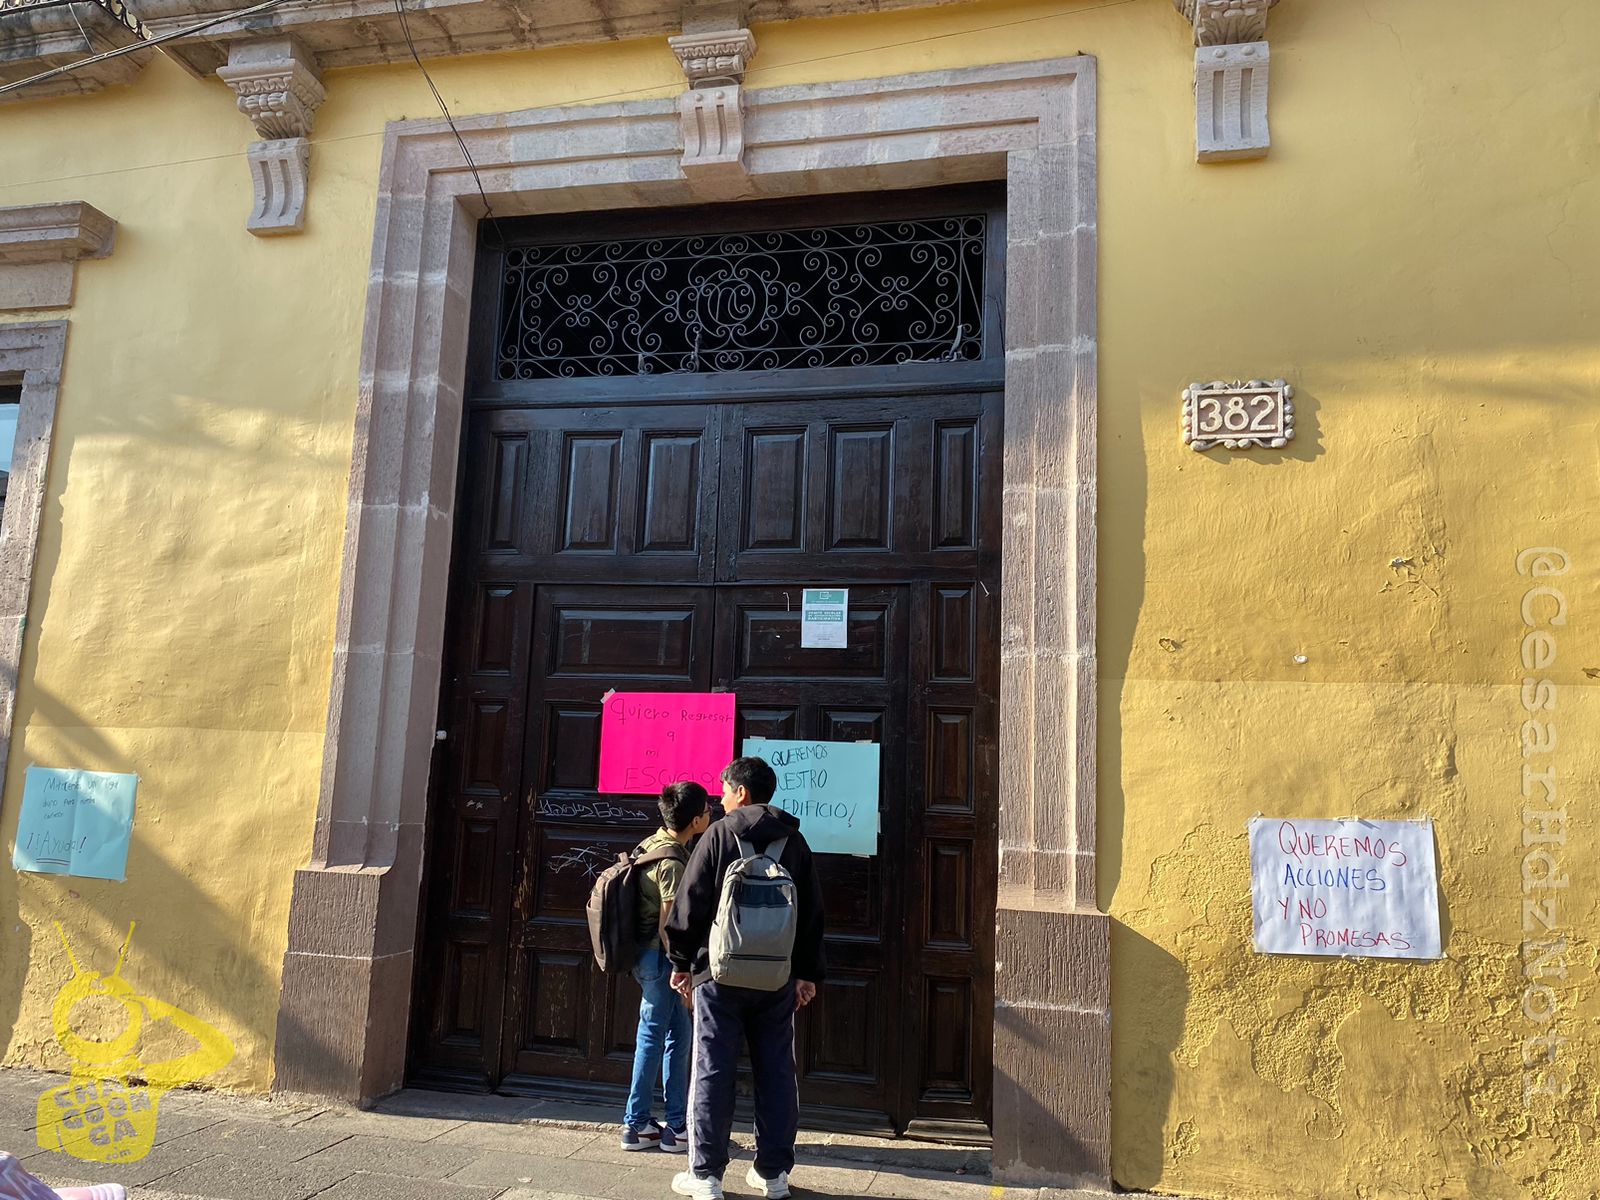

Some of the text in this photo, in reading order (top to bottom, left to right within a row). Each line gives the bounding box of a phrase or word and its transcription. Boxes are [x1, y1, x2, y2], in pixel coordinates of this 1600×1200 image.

[1199, 394, 1276, 432] 382
[771, 744, 828, 767] QUEREMOS
[776, 768, 828, 792] UESTRO
[1278, 821, 1408, 867] QUEREMOS
[1284, 863, 1386, 891] ACCIONES
[1278, 897, 1327, 920] Y NO
